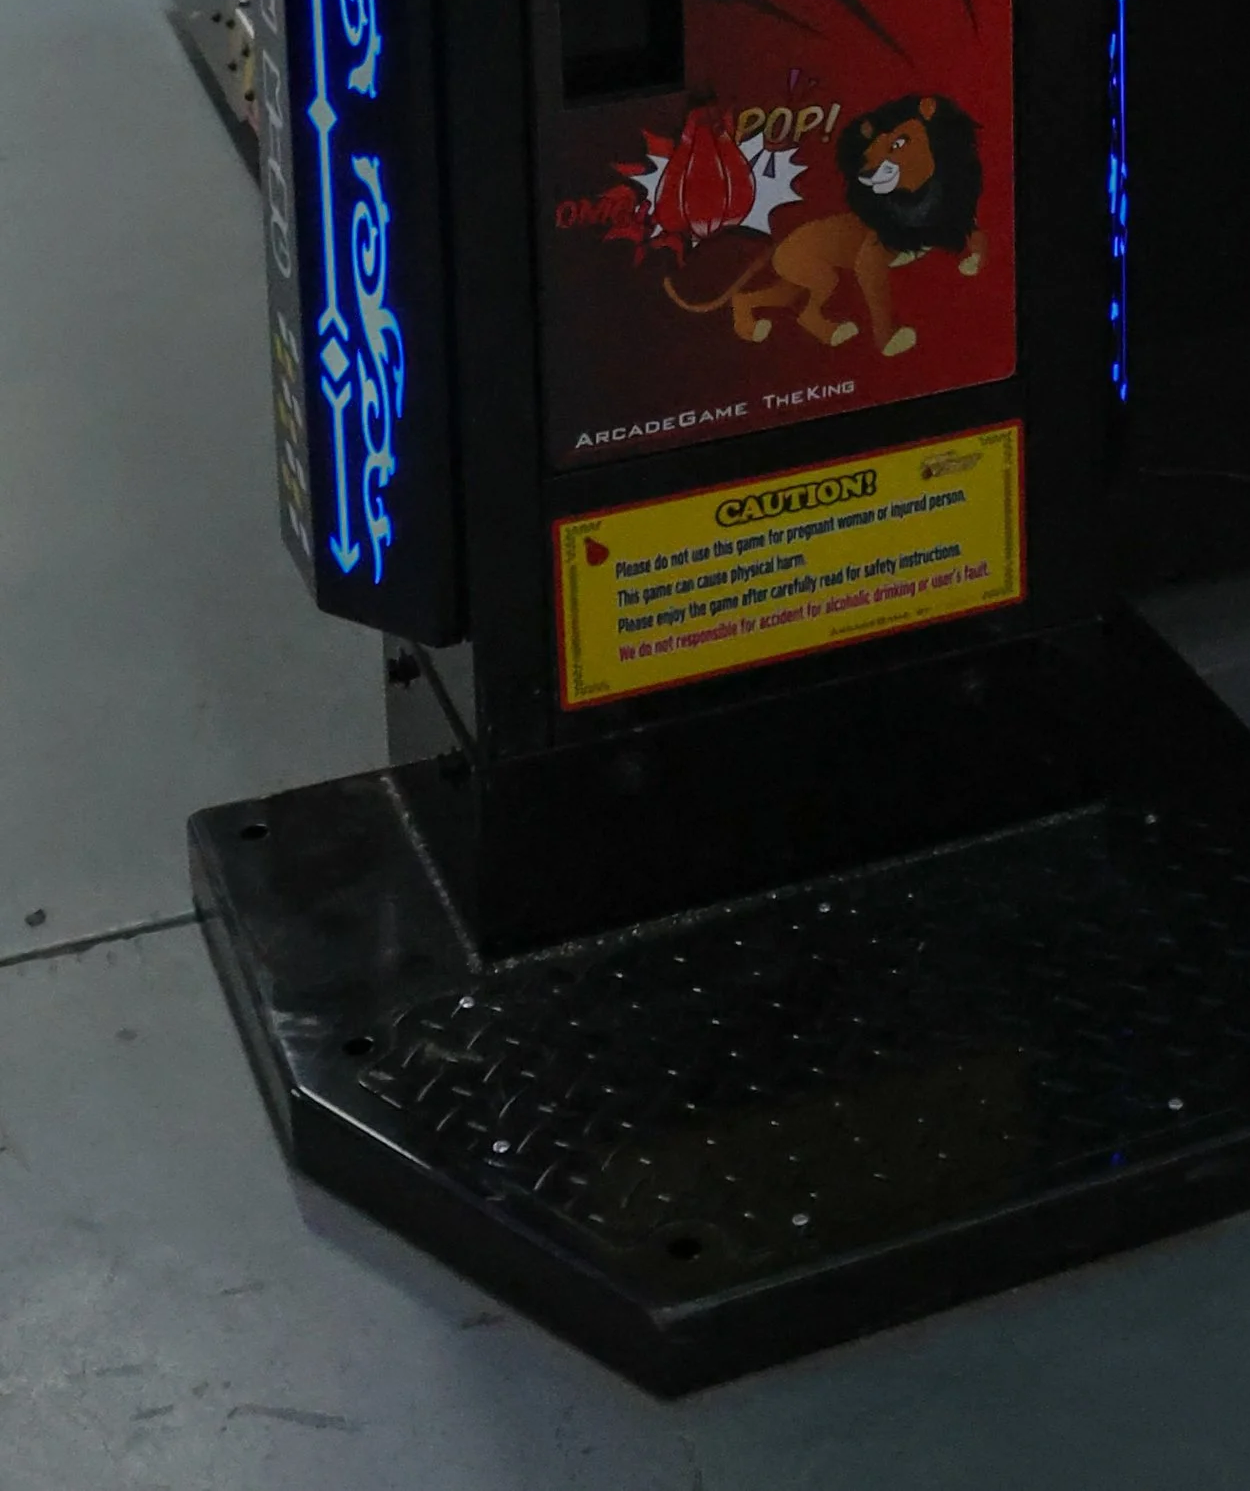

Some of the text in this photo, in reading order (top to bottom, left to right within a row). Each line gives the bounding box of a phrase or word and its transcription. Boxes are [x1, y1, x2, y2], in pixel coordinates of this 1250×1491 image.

[733, 102, 842, 145] POP!
[715, 468, 877, 527] CAUTION!
[616, 560, 651, 580] Please
[655, 554, 668, 571] do
[672, 550, 689, 567] not
[692, 547, 710, 562] use
[714, 540, 734, 557] this
[736, 535, 765, 555] game
[769, 529, 783, 545] for
[787, 517, 835, 544] pregnant
[838, 510, 875, 528] woman
[878, 506, 889, 521] or
[891, 495, 926, 519] injured
[617, 589, 640, 607] This
[643, 583, 673, 605] game
[676, 579, 694, 595] can
[697, 572, 729, 590] cause
[731, 558, 774, 584] physical
[618, 615, 654, 634] Please
[657, 607, 686, 626] enjoy
[689, 600, 706, 617] the
[709, 596, 739, 616] game
[742, 588, 768, 605] after
[771, 575, 818, 600] carefully
[820, 570, 843, 588] read
[846, 563, 861, 580] for
[864, 556, 897, 576] safety
[619, 645, 636, 662] We
[639, 641, 652, 657] do
[655, 636, 673, 653] not
[676, 620, 738, 647] responsible
[741, 617, 756, 633] for
[759, 607, 804, 630] accident
[807, 601, 821, 617] for
[826, 588, 869, 613] alcoholic
[873, 579, 916, 602] drinking
[918, 577, 929, 591] or
[931, 568, 962, 589] user's
